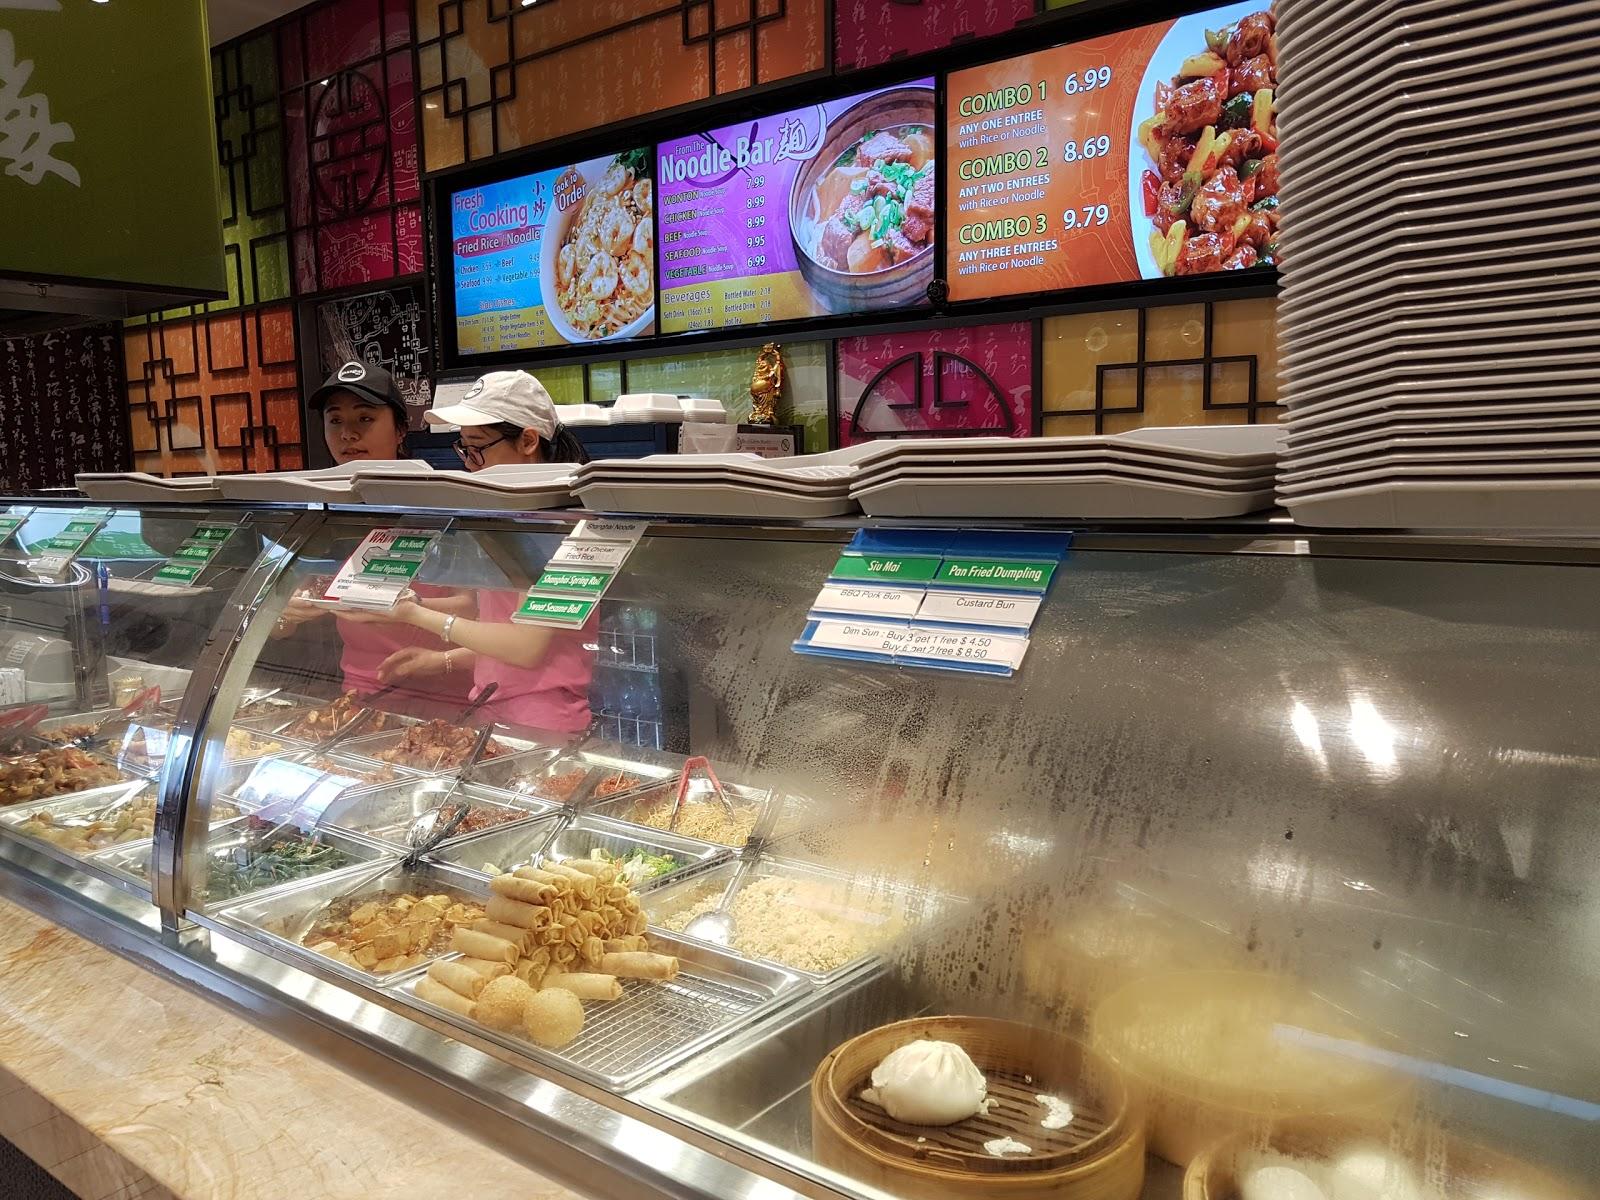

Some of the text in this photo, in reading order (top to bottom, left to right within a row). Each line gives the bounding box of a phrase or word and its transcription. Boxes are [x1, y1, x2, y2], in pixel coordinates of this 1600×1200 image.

[1063, 65, 1112, 96] 6.99
[958, 80, 1047, 117] COMBO 1
[959, 109, 1043, 135] ANY ONE ENTREE
[959, 124, 1046, 148] with Rice or Noodle
[675, 141, 704, 155] From The
[1063, 135, 1111, 163] 8.69
[660, 136, 774, 185] Noodle Bar
[958, 146, 1048, 180] COMBO 2
[553, 173, 578, 196] Cook to
[746, 176, 765, 189] 7.99
[959, 174, 1050, 198] ANY TWO ENTREES
[454, 191, 484, 211] Fresh
[559, 183, 586, 211] Order
[663, 190, 699, 205] WONTON
[746, 196, 765, 209] 8.99
[959, 189, 1045, 211] with Rice or Noodle
[469, 203, 528, 231] Cooking
[664, 209, 697, 224] CHICKEN
[747, 216, 765, 229] 8.99
[1063, 204, 1109, 230] 9.79
[664, 232, 682, 243] BEEF
[958, 214, 1048, 245] COMBO 3
[457, 241, 478, 255] Fried
[481, 237, 499, 250] Rice
[507, 229, 541, 245] Noodle
[747, 236, 765, 248] 9.95
[664, 247, 701, 261] SEAFOOD
[958, 239, 1057, 263] ANY THREE ENTREES
[501, 257, 514, 268] Beef
[747, 255, 766, 268] 6.99
[958, 256, 1044, 275] with Rice or Noodle
[502, 270, 528, 283] Vegetable
[665, 264, 707, 280] VEGETABLE
[461, 279, 480, 288] Seafood
[664, 289, 711, 304] Beverages
[867, 560, 902, 573] Siu Mai
[948, 565, 1043, 582] Pan Fried Dumpling
[541, 574, 569, 586] Shanghai
[568, 575, 590, 587] Spring
[840, 589, 901, 600] BBQ Pork Bun
[956, 597, 1015, 609] Custard Bun
[527, 601, 547, 611] Sweet
[843, 626, 860, 635] Dim
[862, 628, 879, 637] Sun
[887, 631, 905, 642] Buy
[906, 633, 913, 641] 3
[915, 634, 931, 645] get
[940, 635, 957, 645] free
[960, 636, 967, 645] $
[969, 637, 991, 647] 4.50
[882, 640, 900, 651] Buy
[936, 646, 953, 656] free
[956, 647, 963, 656] $
[965, 648, 987, 658] 8.50
